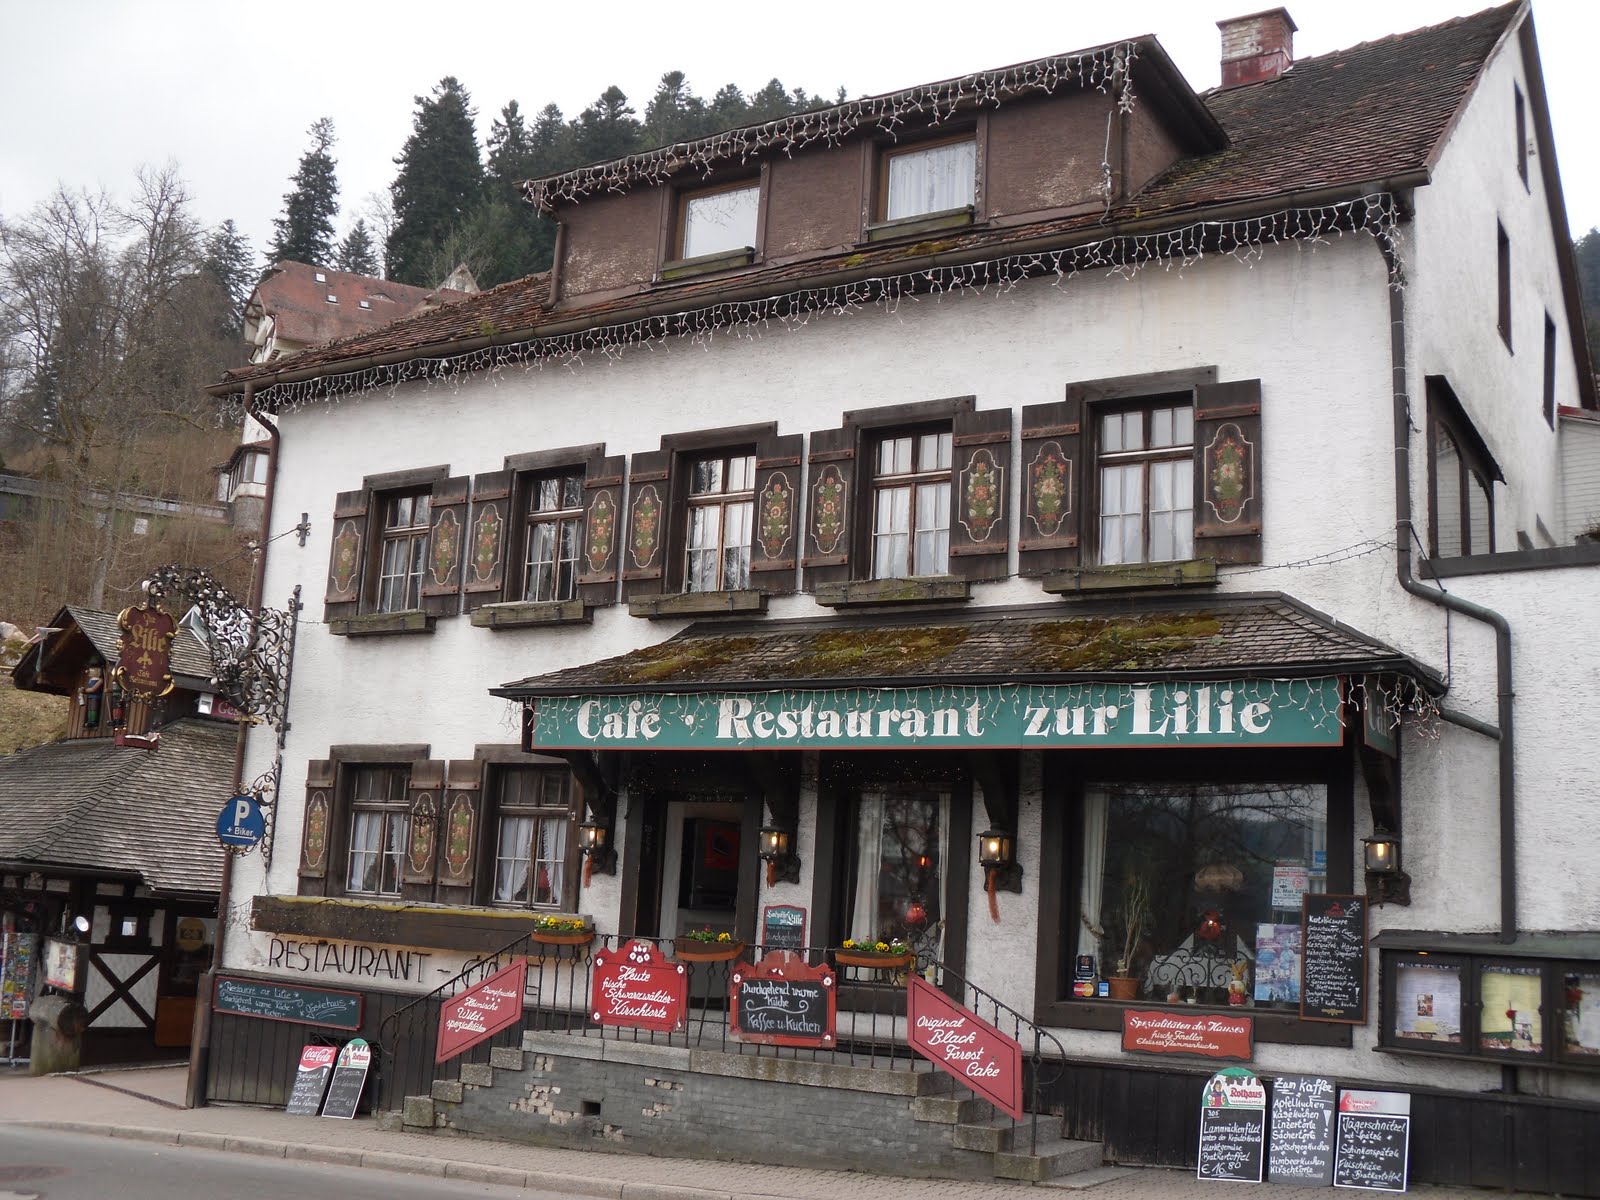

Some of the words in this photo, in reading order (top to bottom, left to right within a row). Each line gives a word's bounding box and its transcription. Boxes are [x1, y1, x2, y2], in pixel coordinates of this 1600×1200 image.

[130, 624, 167, 652] Lilie
[715, 696, 985, 739] Restaurant
[1023, 702, 1118, 738] zur
[1129, 686, 1271, 738] Lilie
[234, 800, 250, 826] P
[234, 826, 254, 836] Biker
[268, 938, 432, 983] RESTAURANT
[461, 955, 541, 996] CAE
[617, 965, 651, 982] Heute
[742, 981, 790, 999] Durchgehend
[464, 996, 498, 1011] Heimische
[607, 998, 667, 1018] Kirschtorte
[767, 996, 790, 1008] Küche
[747, 1013, 775, 1032] Kaffee
[917, 1015, 966, 1031] Original
[1129, 1016, 1191, 1029] Spezialitäten
[1191, 1021, 1206, 1032] des
[1207, 1021, 1245, 1034] Hauses
[927, 1029, 977, 1046] Black
[944, 1044, 984, 1060] Forest
[966, 1061, 1000, 1077] Cake
[1230, 1087, 1263, 1100] Rothaus
[1299, 1077, 1334, 1096] Kaffee
[1273, 1095, 1325, 1112] Apfelkuchen
[1342, 1116, 1407, 1135] Jägerschnitzel
